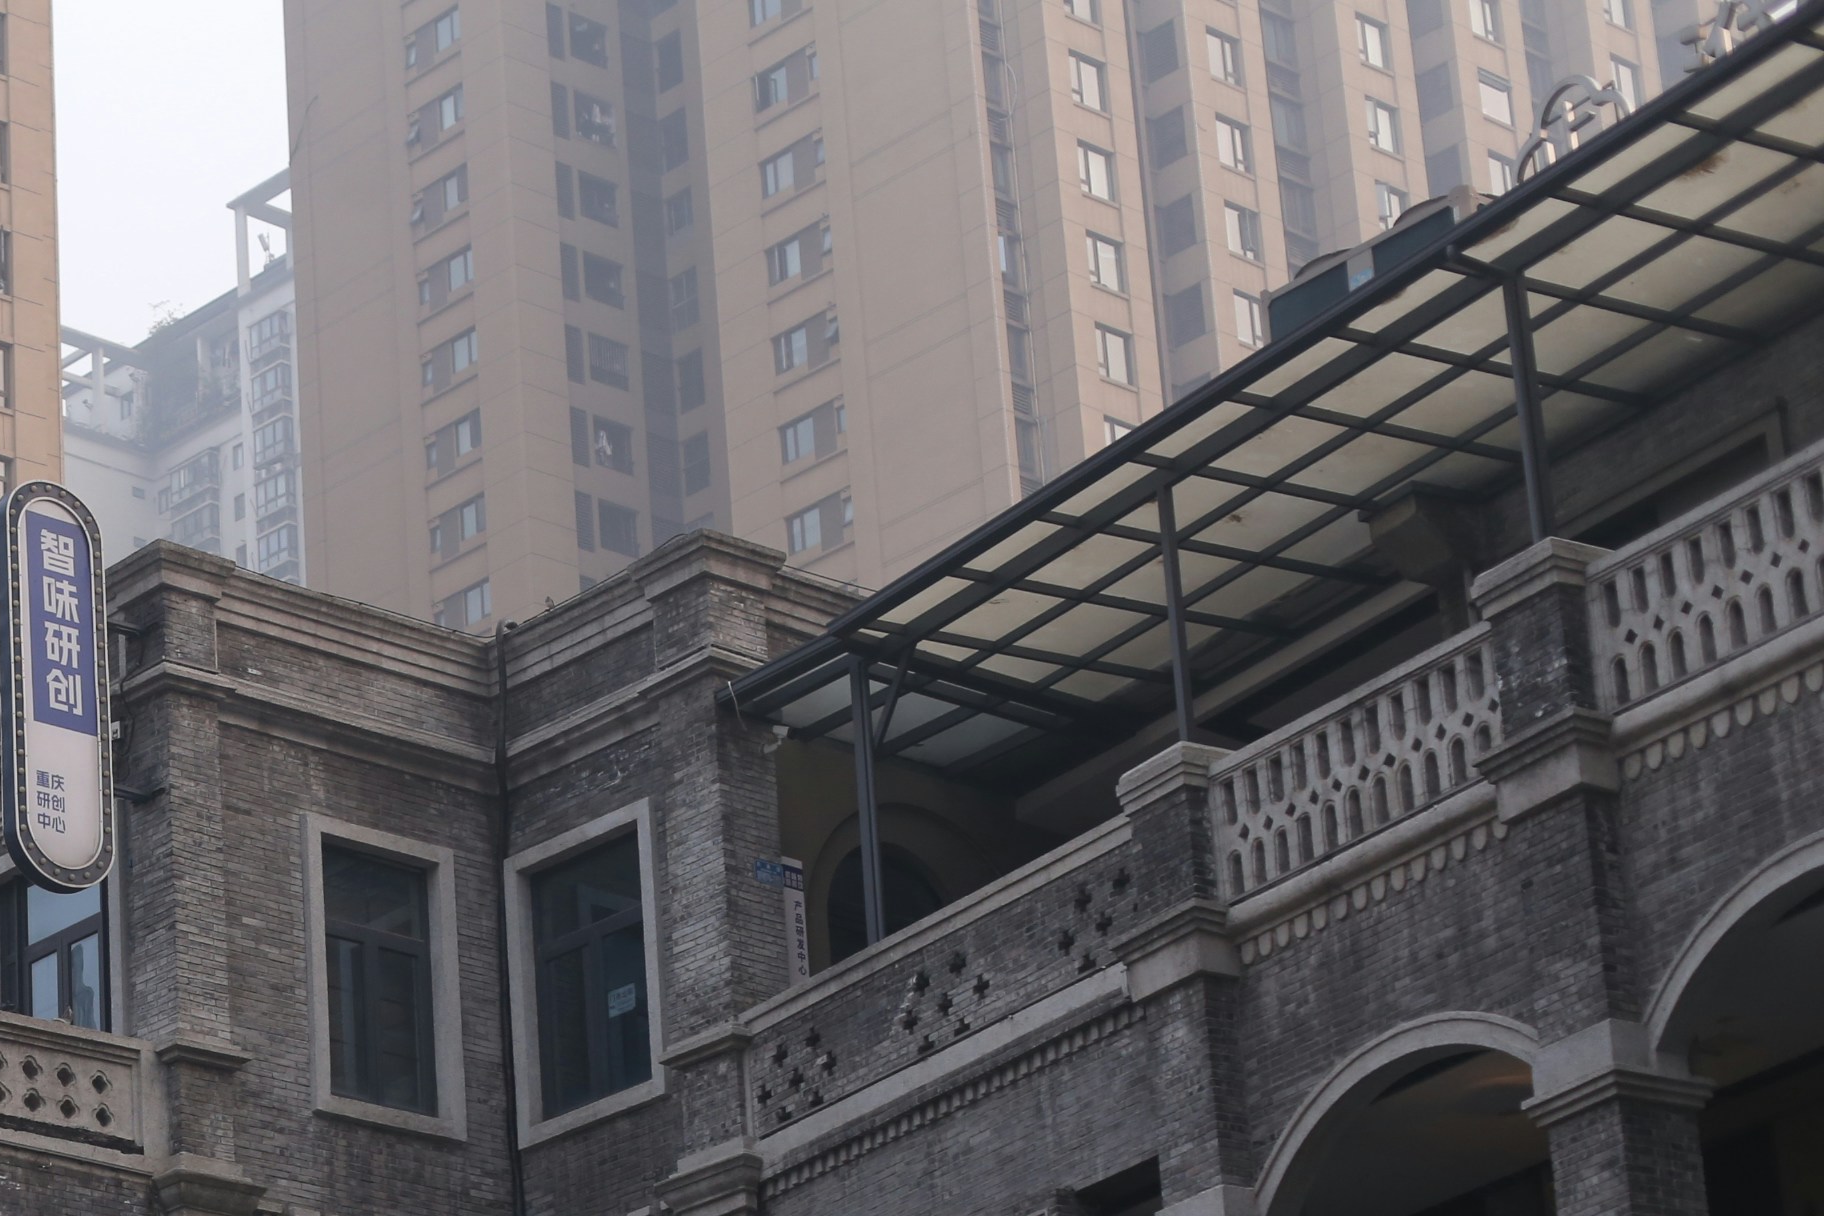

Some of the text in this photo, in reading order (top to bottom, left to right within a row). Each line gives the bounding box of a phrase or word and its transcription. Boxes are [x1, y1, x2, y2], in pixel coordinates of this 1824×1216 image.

[40, 529, 83, 717] 智味研创
[36, 770, 65, 792] 重庆
[37, 790, 65, 813] 研创
[37, 812, 66, 834] 中心
[793, 900, 806, 976] 产品研发中心
